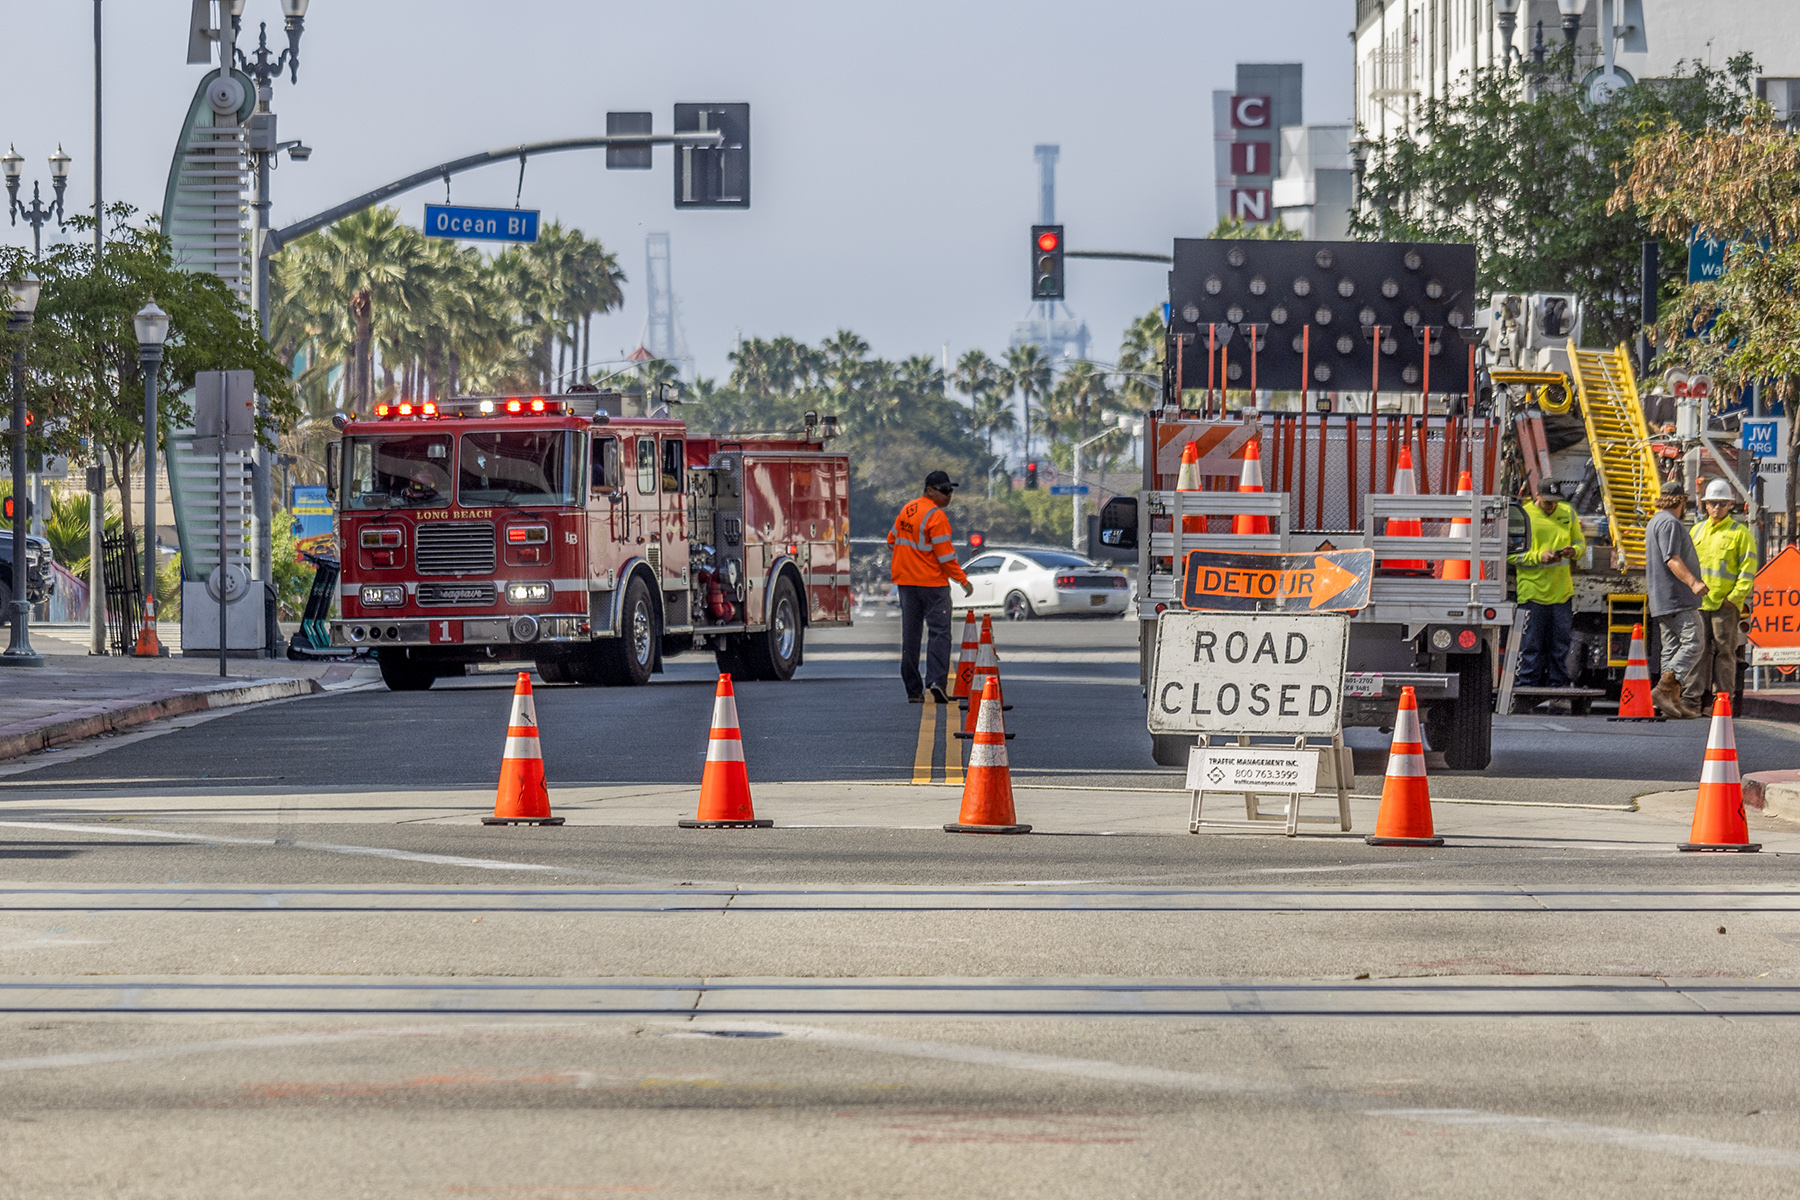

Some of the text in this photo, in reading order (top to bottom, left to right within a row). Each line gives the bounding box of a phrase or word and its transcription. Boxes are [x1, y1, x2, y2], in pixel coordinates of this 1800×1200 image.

[437, 213, 526, 236] Ocean Bl
[1748, 425, 1772, 441] JW
[1748, 442, 1772, 453] ORG
[416, 510, 493, 520] LONG BEACH
[565, 532, 578, 544] LB
[1203, 570, 1315, 595] DETOUR
[432, 586, 483, 603] eagrave
[1753, 589, 1800, 607] DETO
[439, 621, 452, 641] 1
[1194, 631, 1308, 664] ROAD
[1160, 682, 1332, 717] CLOSED
[1209, 757, 1235, 766] TRAFFIC
[1236, 758, 1285, 767] MANAGEMENT
[1235, 769, 1299, 780] 800 763.3999
